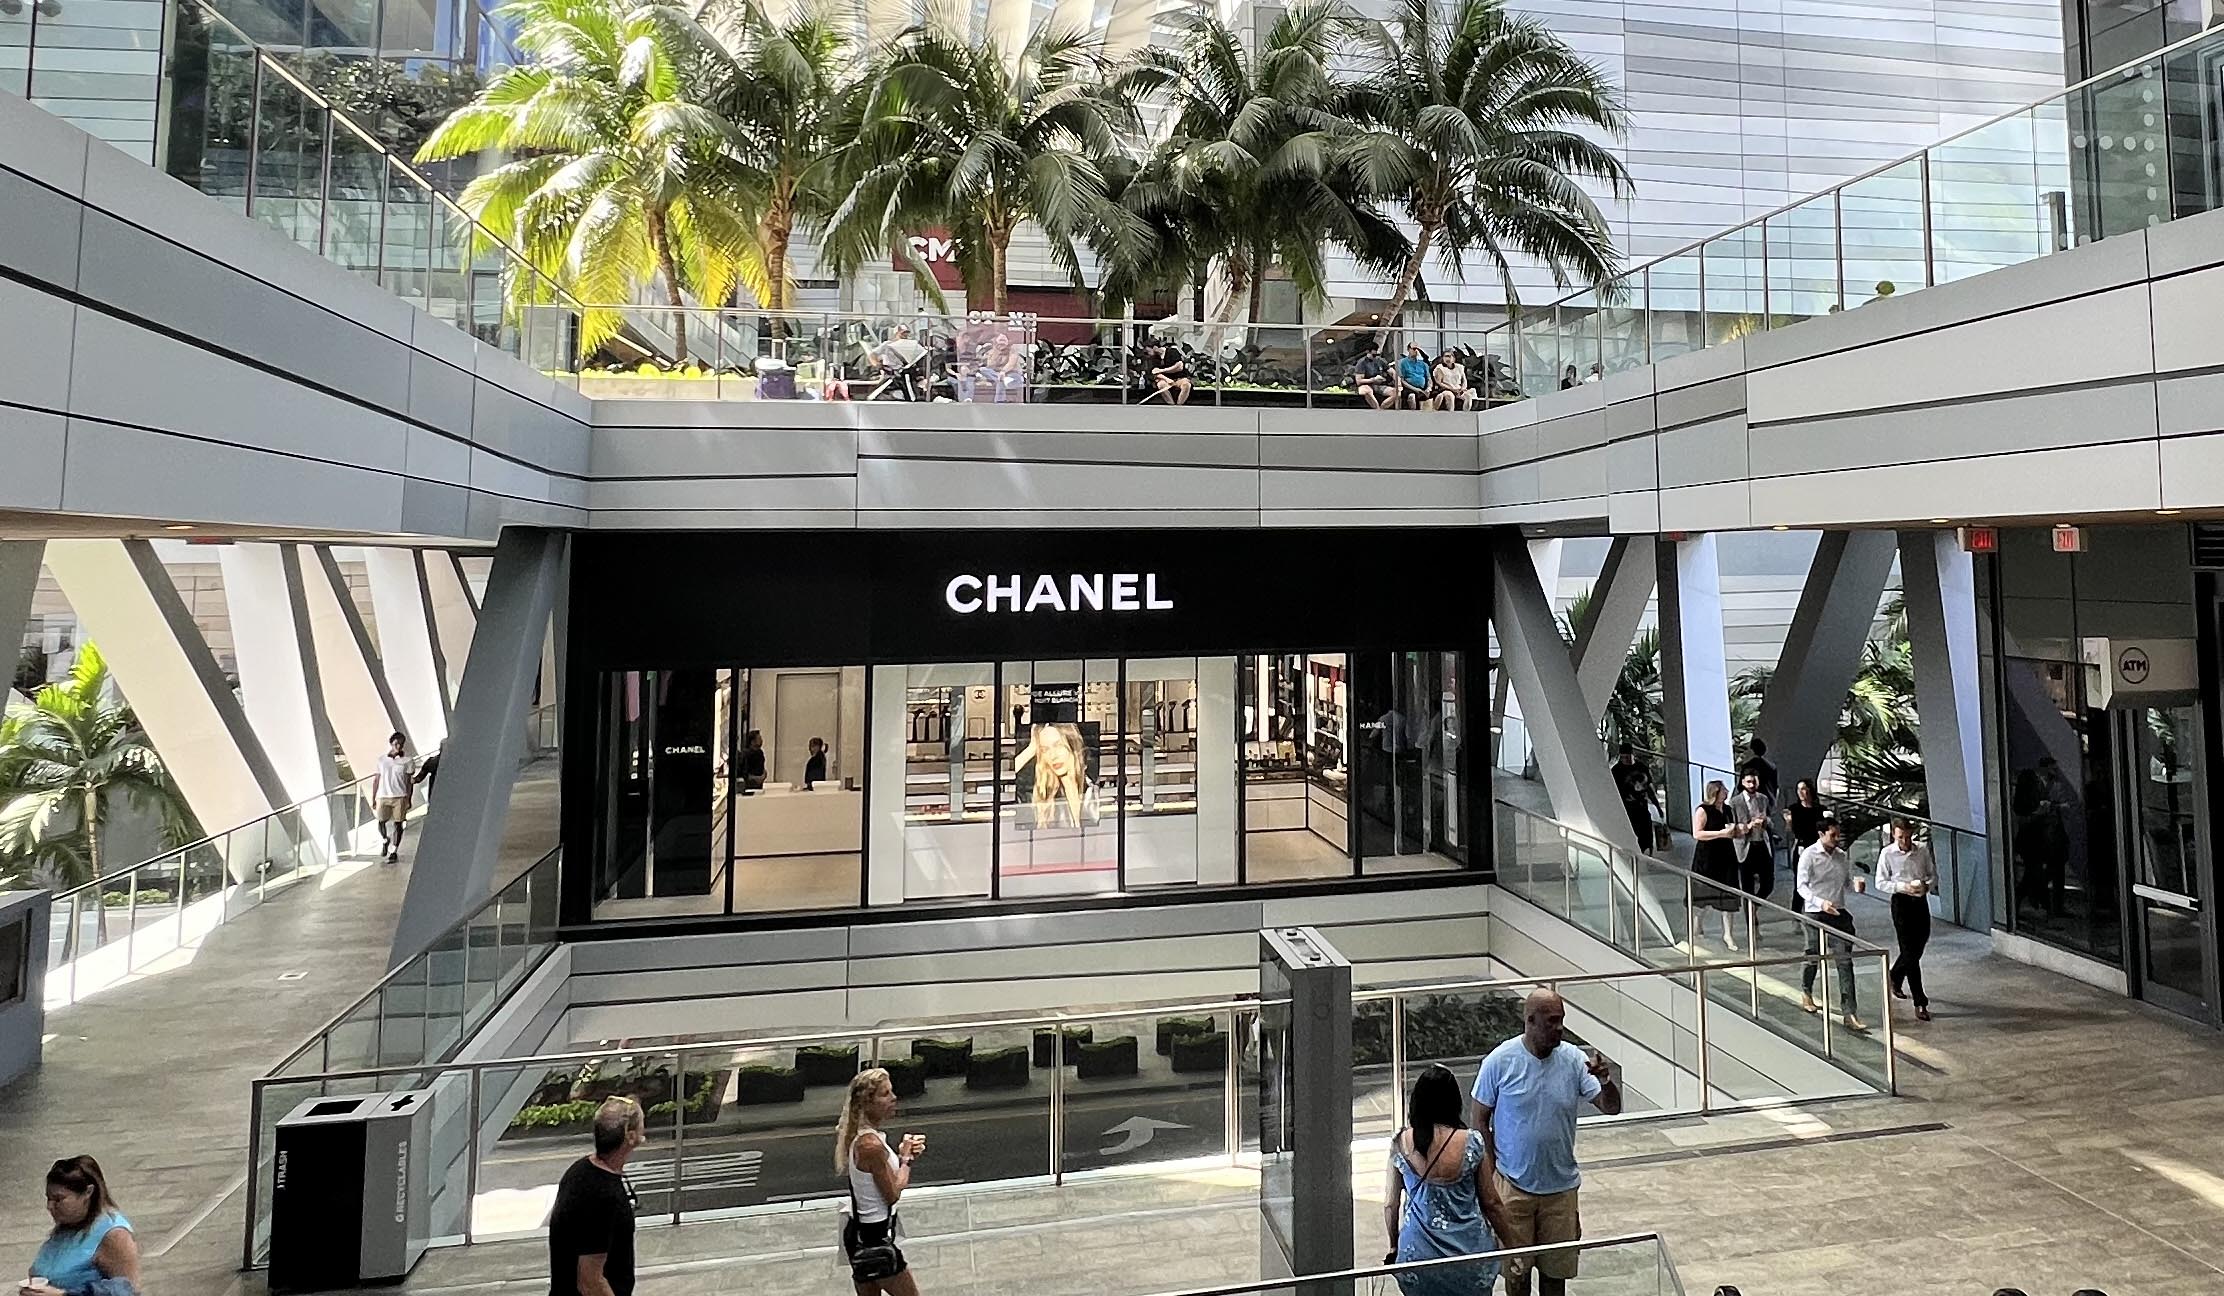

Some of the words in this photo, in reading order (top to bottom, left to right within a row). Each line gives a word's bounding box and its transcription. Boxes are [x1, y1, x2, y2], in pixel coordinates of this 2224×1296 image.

[945, 573, 1174, 614] CHANEL
[2122, 659, 2147, 671] ATM
[664, 745, 706, 754] CHANEL
[277, 1151, 288, 1184] TRASH
[396, 1141, 408, 1213] RECYCLABLES
